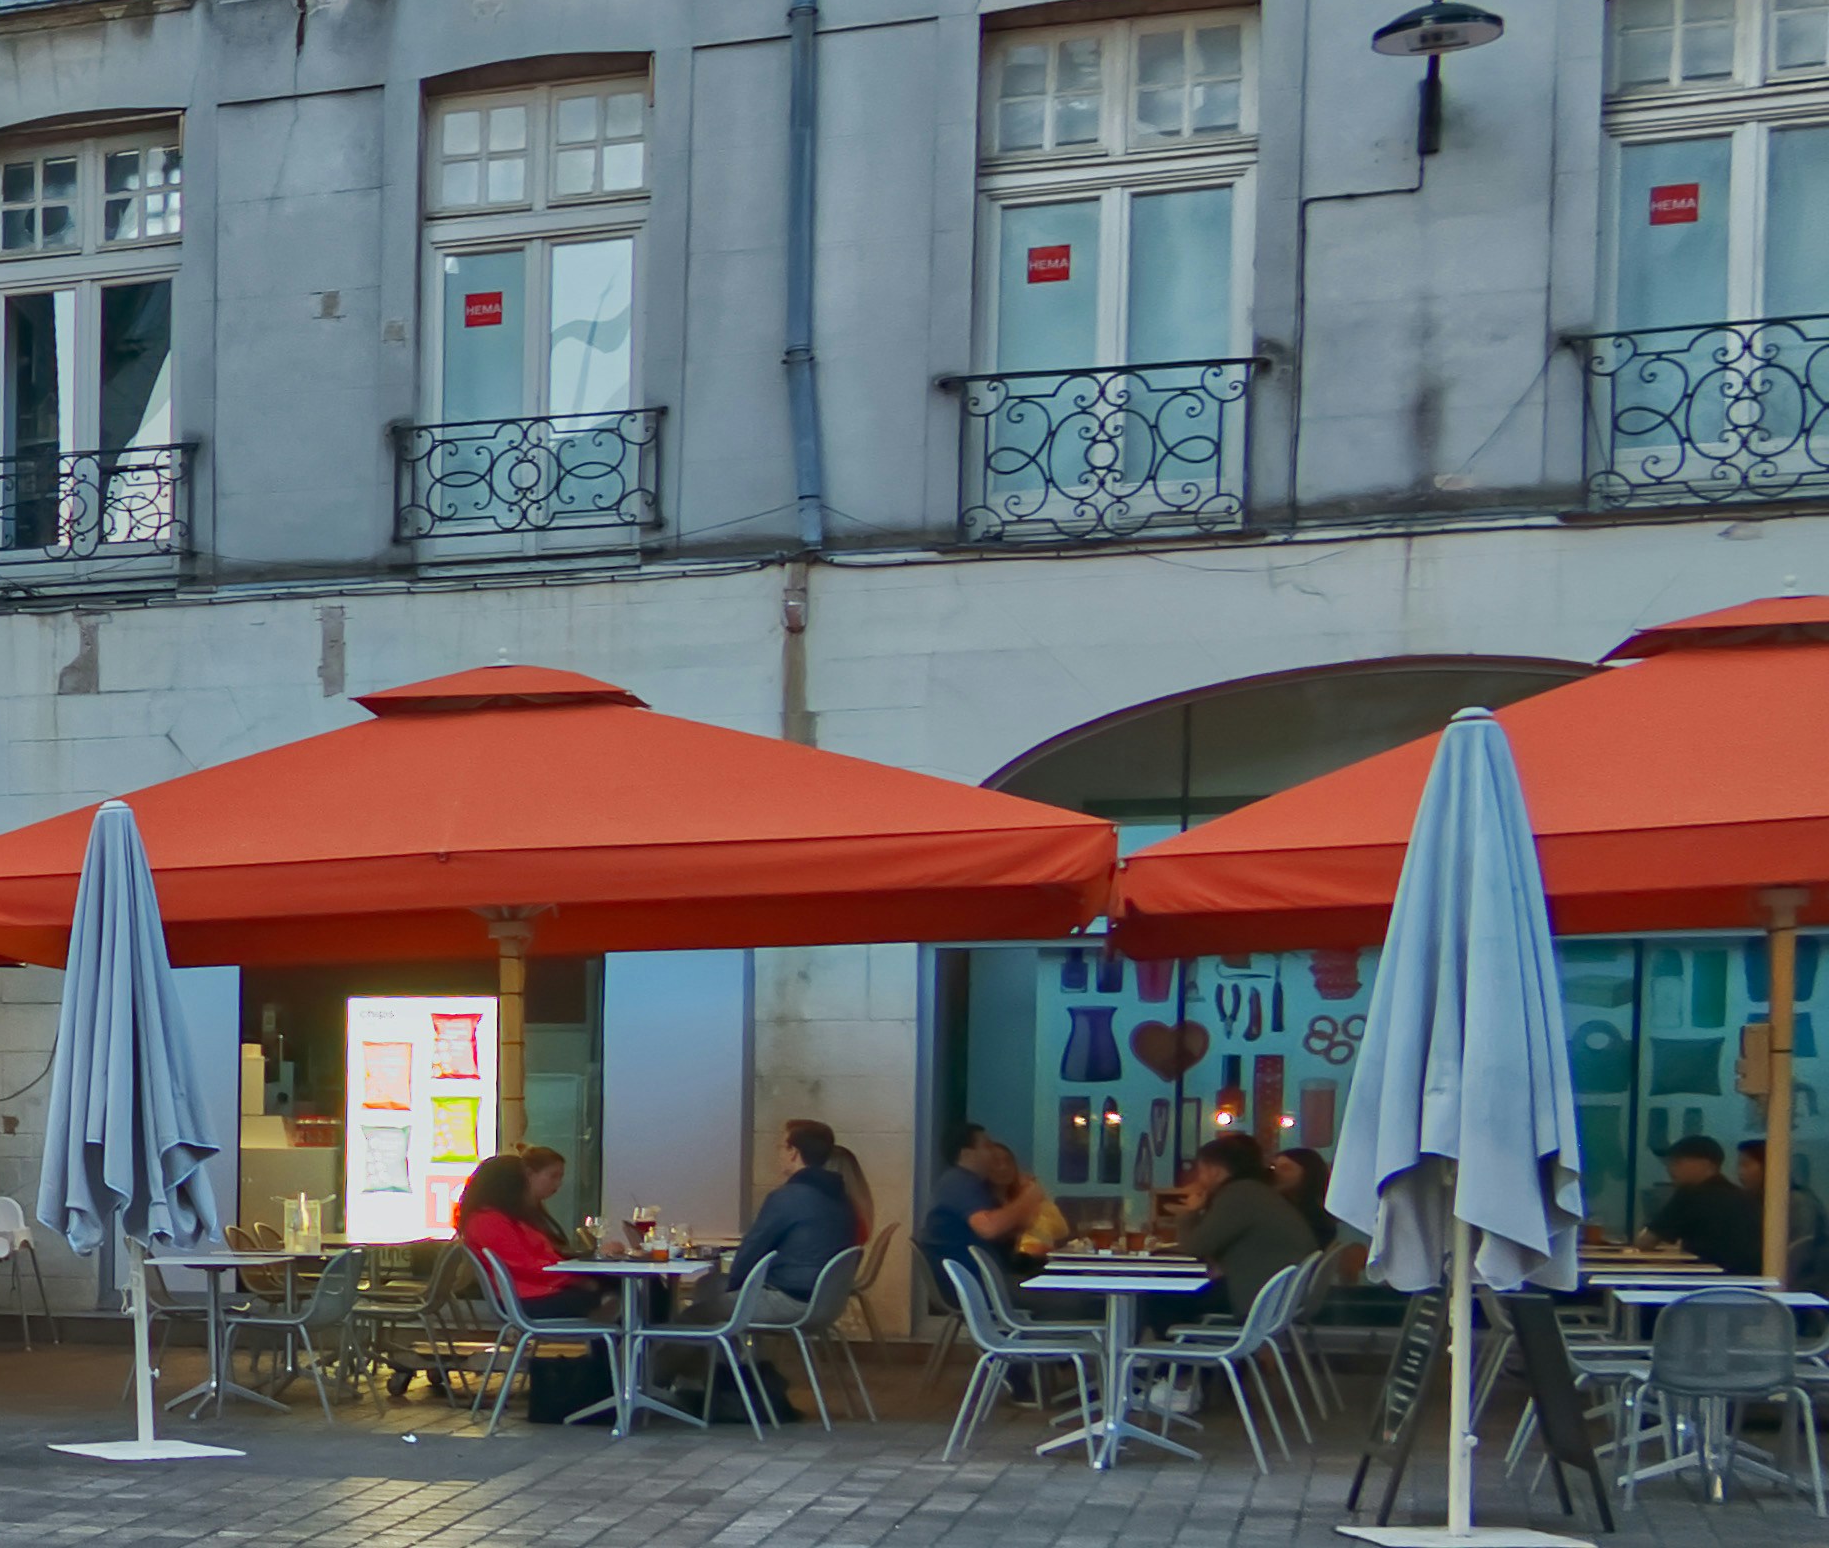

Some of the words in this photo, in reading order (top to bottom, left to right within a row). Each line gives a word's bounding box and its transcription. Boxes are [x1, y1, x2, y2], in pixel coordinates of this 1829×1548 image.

[1651, 198, 1697, 212] HEMA
[1029, 258, 1069, 271] HEMA
[466, 304, 501, 316] HEMA
